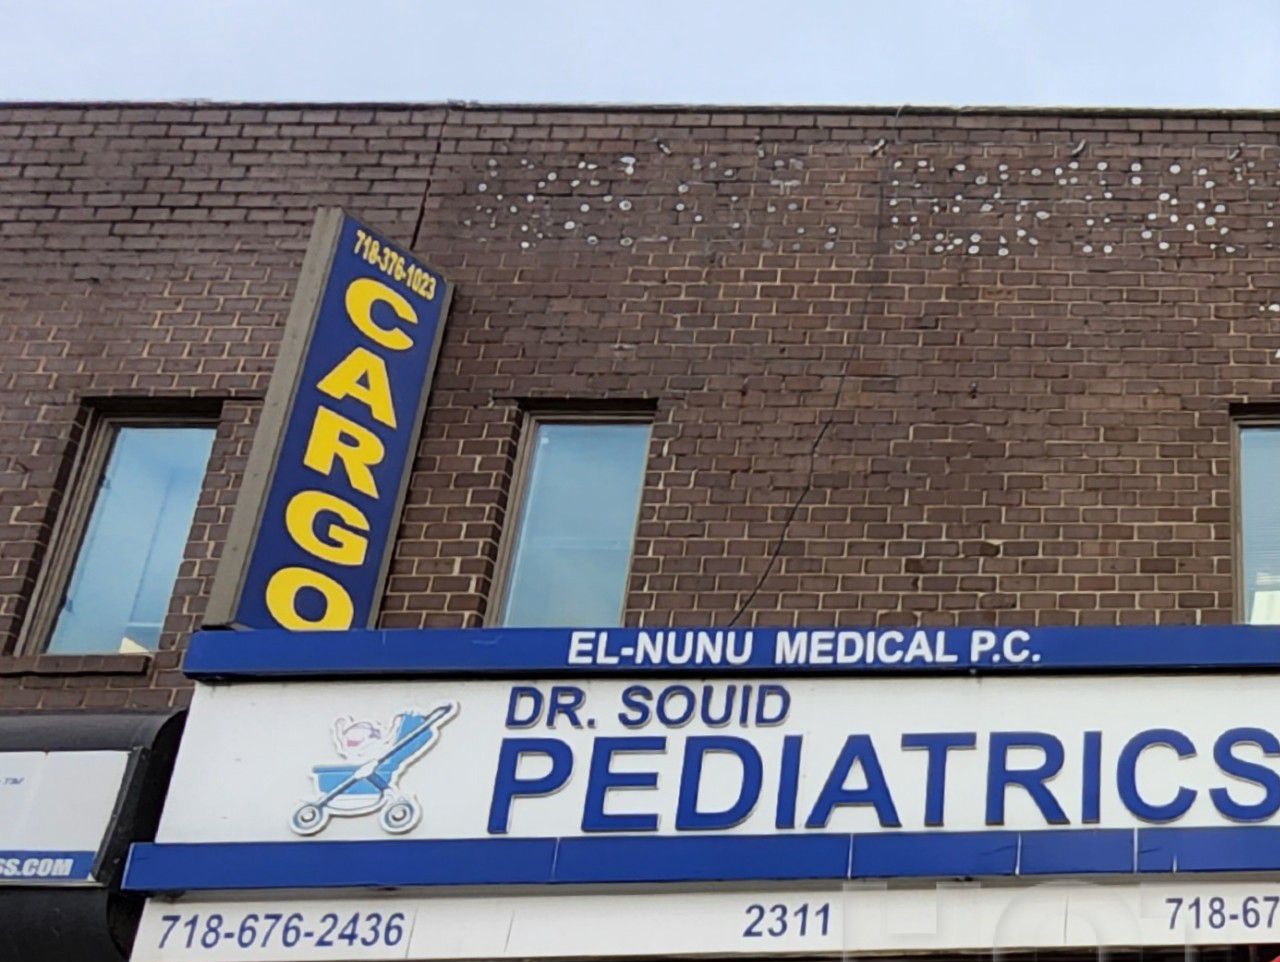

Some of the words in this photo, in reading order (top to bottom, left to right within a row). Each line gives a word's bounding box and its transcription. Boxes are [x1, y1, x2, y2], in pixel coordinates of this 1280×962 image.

[354, 229, 436, 300] 718-376-1023
[265, 278, 419, 631] CARGO
[567, 631, 754, 666] EL-NUNU
[775, 630, 957, 665] MEDICAL
[970, 630, 1041, 663] P.C.
[505, 685, 596, 729] DR.
[618, 684, 791, 729] SOUID
[158, 913, 405, 948] 718-676-2436
[743, 903, 831, 937] 2311
